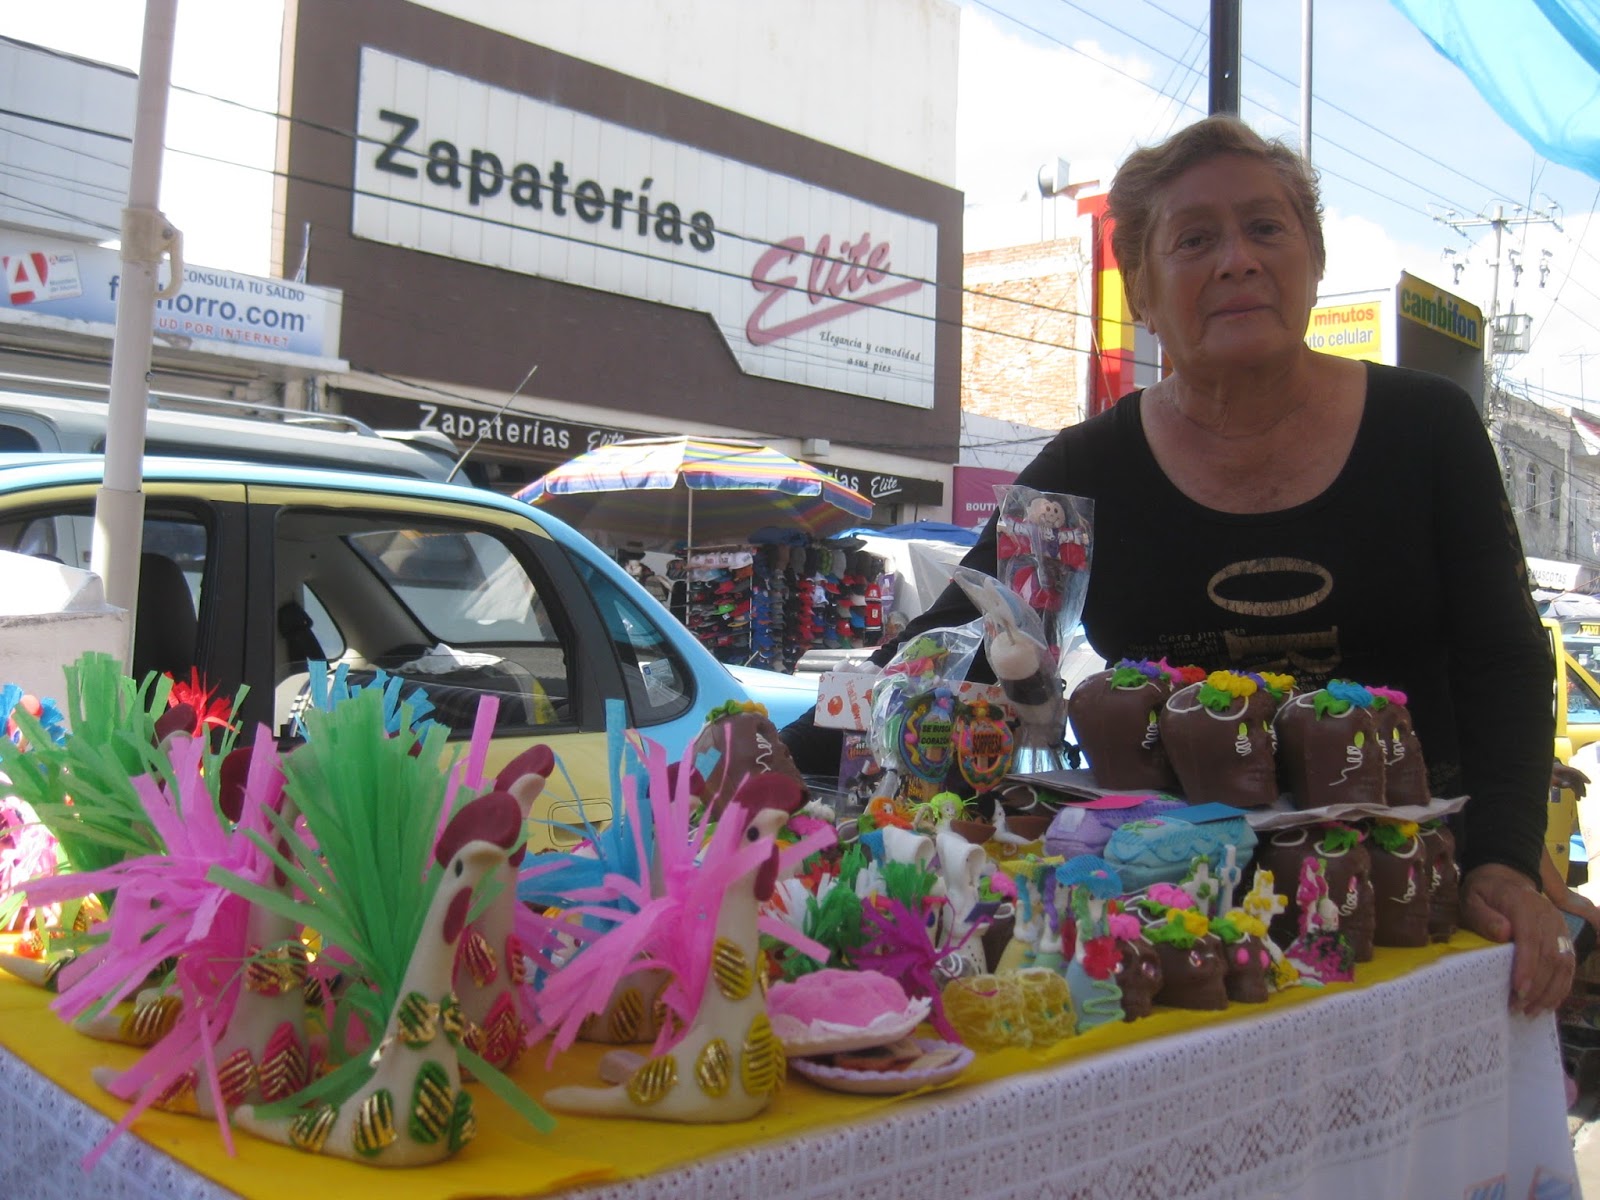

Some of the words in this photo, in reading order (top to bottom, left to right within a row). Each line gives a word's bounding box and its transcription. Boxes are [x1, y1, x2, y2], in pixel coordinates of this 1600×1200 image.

[374, 109, 716, 252] Zapaterías
[249, 280, 263, 295] TU
[265, 285, 305, 301] SALDO
[745, 232, 923, 346] Elite
[1314, 307, 1374, 326] minutos
[1401, 287, 1477, 343] cambifon
[185, 321, 214, 335] POR
[220, 327, 290, 347] INTERNET
[1304, 333, 1325, 348] uto
[1328, 327, 1374, 347] celular
[819, 331, 862, 347] Elegancia
[866, 343, 871, 354] y
[875, 344, 921, 362] comodidad
[873, 362, 891, 373] pies
[587, 431, 624, 452] Elite
[870, 476, 902, 498] Elite
[966, 503, 996, 511] BOUTI
[1581, 625, 1600, 635] TAXI
